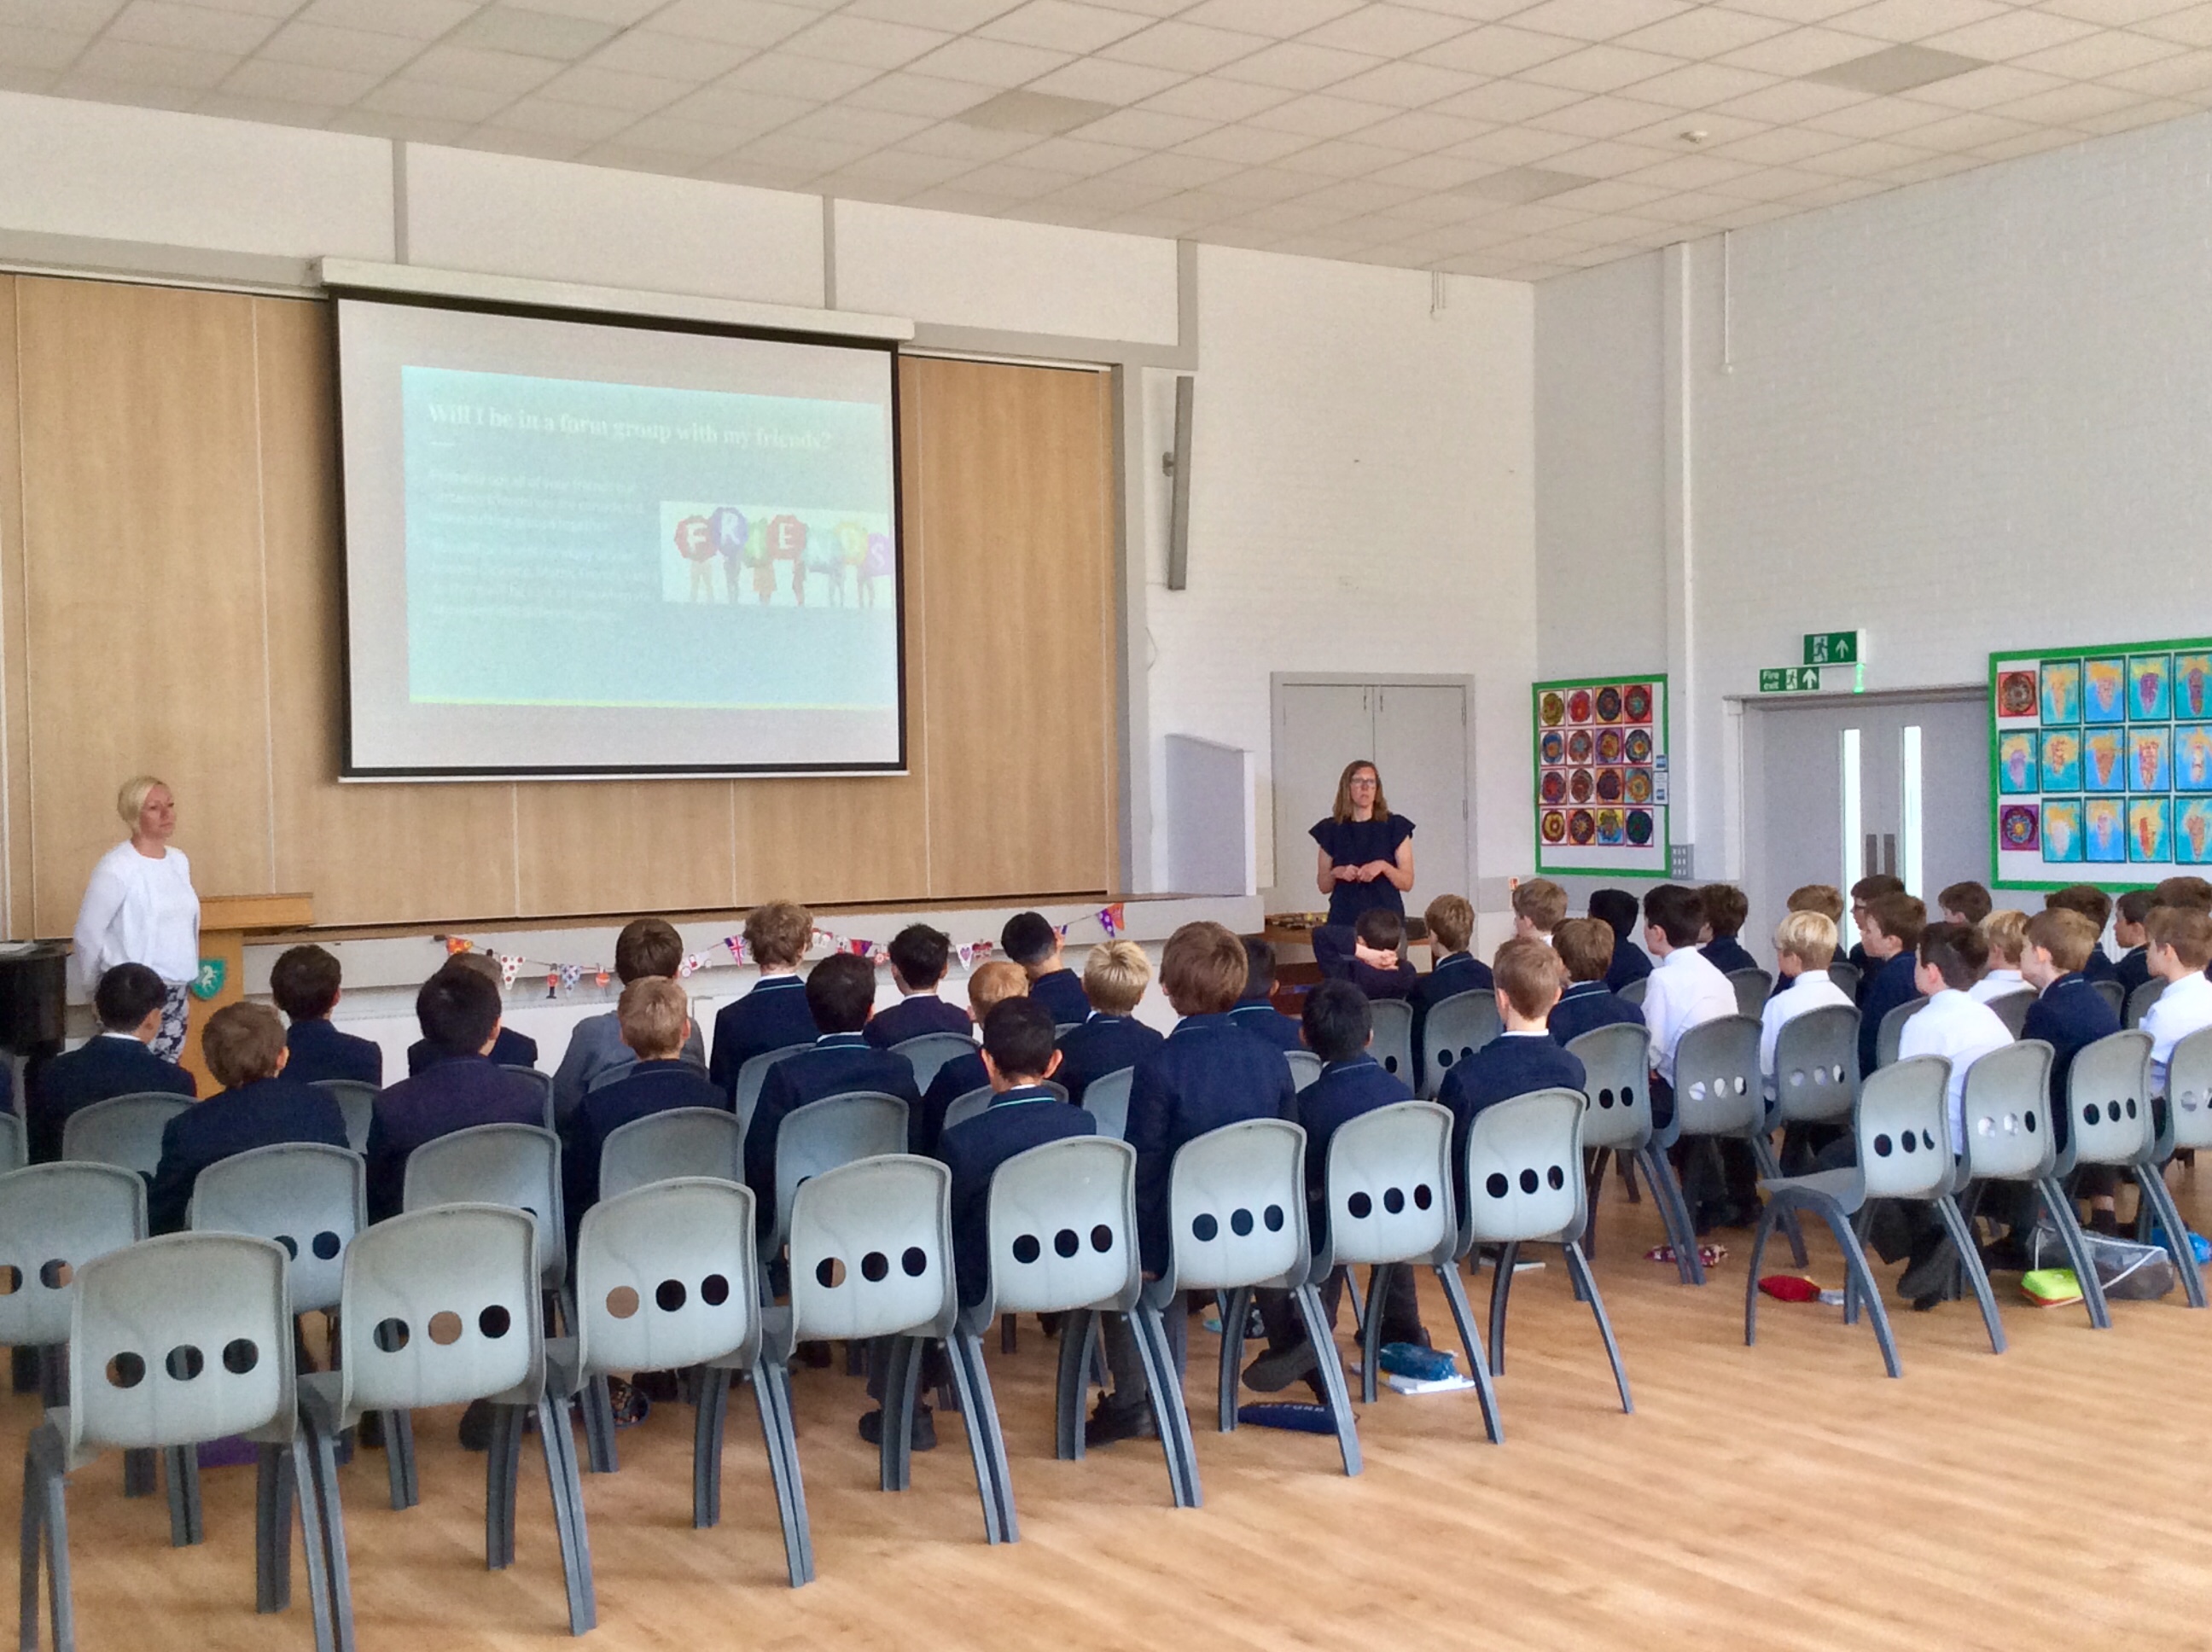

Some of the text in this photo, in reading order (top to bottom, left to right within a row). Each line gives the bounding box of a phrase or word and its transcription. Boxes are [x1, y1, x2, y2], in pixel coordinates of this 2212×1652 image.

[428, 403, 470, 425] Will
[476, 407, 484, 425] I
[489, 406, 512, 428] be
[519, 409, 538, 430] in
[544, 416, 555, 432] a
[560, 413, 608, 436] form
[612, 422, 672, 444] group
[676, 422, 718, 443] with
[725, 429, 749, 450] my
[1762, 671, 1779, 680] Fire
[1763, 682, 1779, 690] exit
